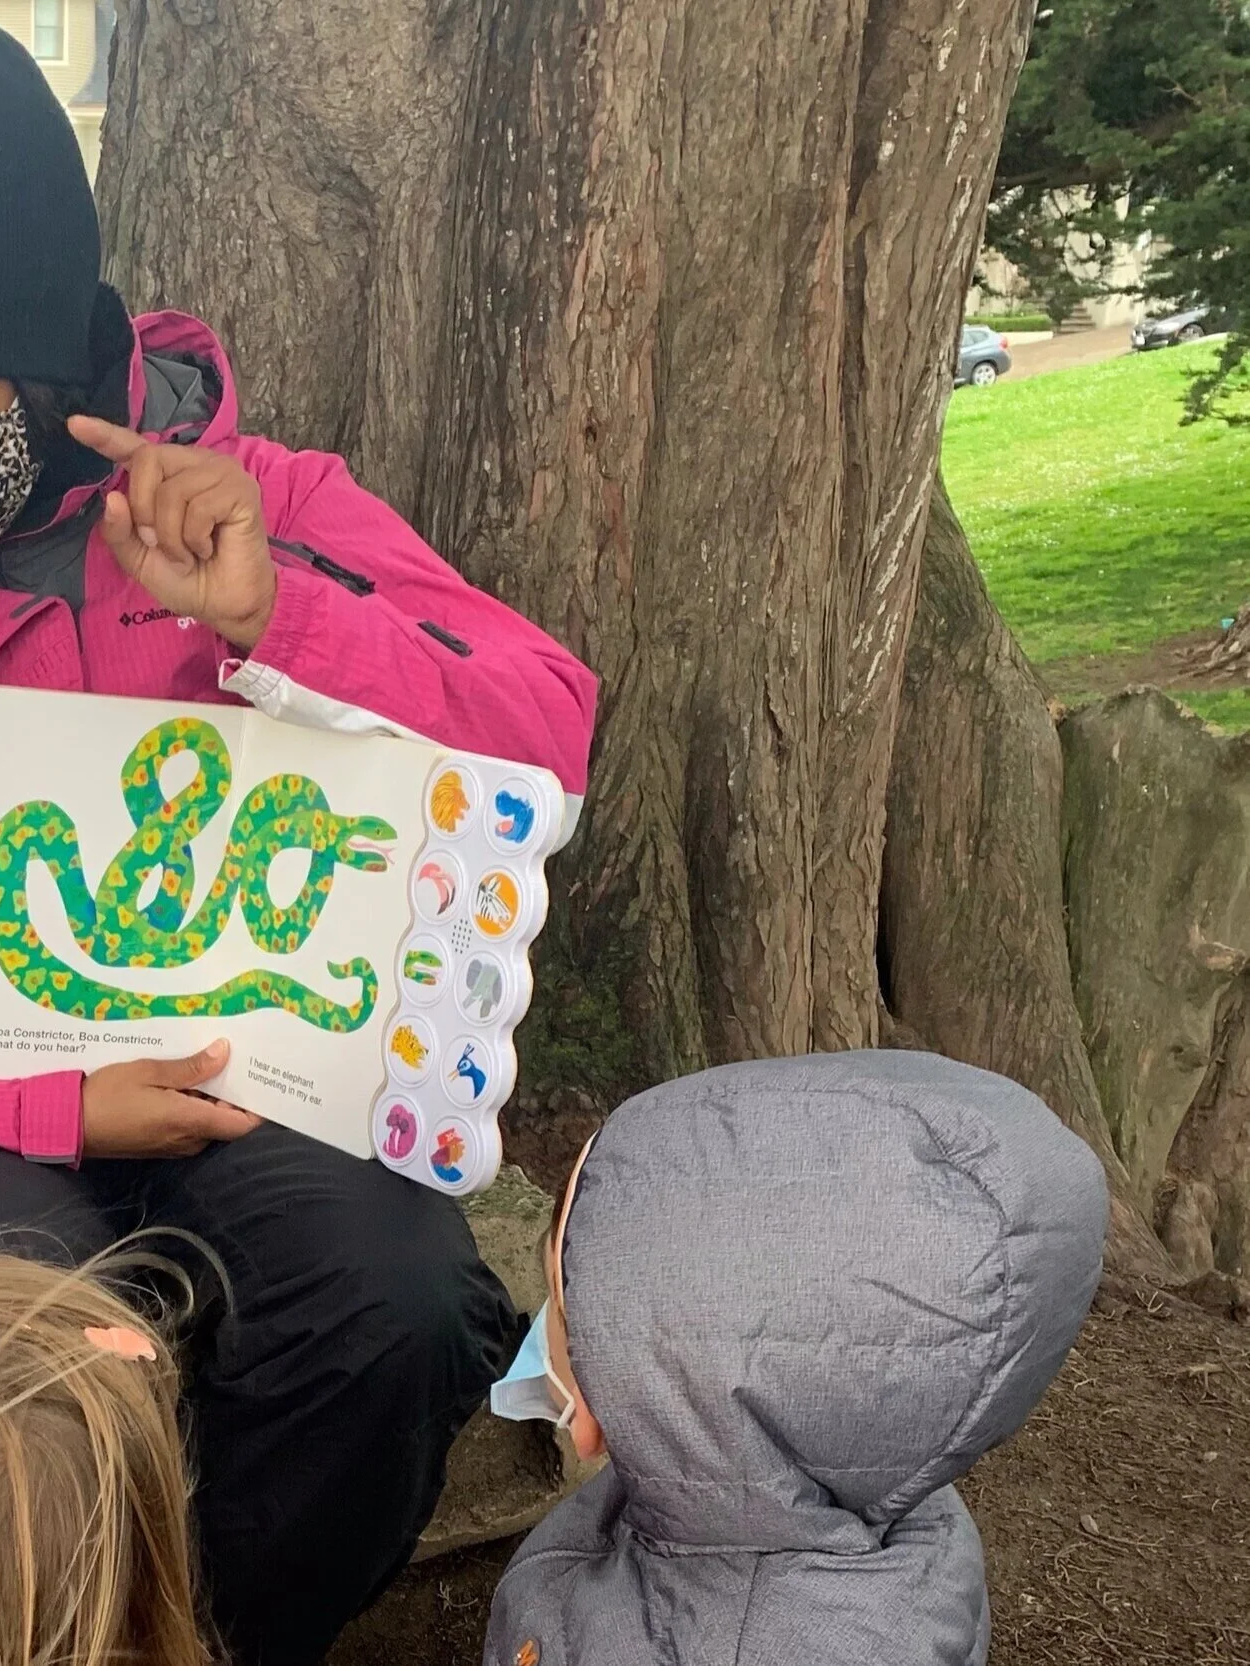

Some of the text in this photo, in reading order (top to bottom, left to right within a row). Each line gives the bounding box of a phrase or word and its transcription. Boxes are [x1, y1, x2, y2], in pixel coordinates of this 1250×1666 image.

[132, 608, 180, 625] Colum
[13, 1028, 75, 1042] Constrictor,
[79, 1032, 100, 1042] Boa
[103, 1033, 163, 1047] Constrictor,
[16, 1041, 30, 1050] do
[34, 1043, 53, 1053] you
[56, 1043, 86, 1054] hear?
[254, 1058, 270, 1072] hear
[271, 1066, 281, 1076] an
[282, 1071, 314, 1089] elephant
[247, 1070, 287, 1094] trumpeting
[288, 1086, 295, 1095] in
[296, 1089, 308, 1102] my
